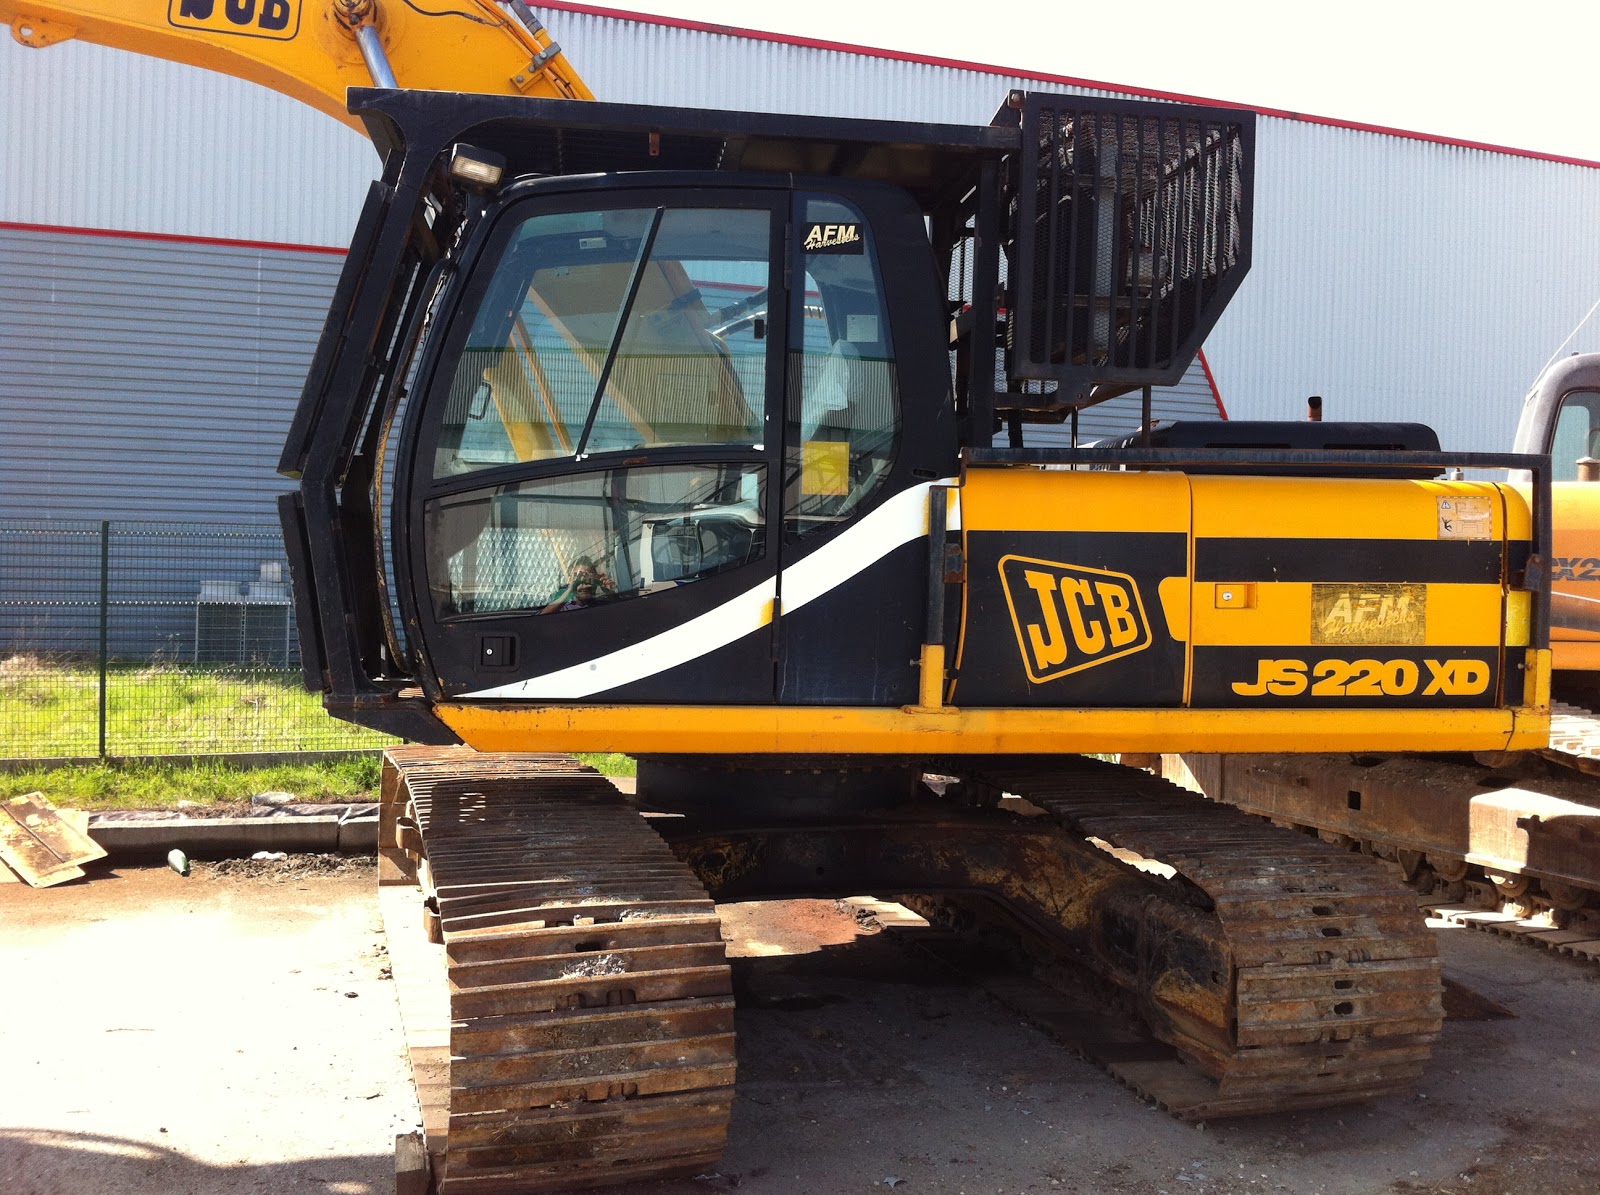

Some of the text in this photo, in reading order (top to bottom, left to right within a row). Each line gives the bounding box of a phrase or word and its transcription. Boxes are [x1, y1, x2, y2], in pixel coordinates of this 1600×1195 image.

[804, 225, 856, 245] AFM
[1024, 569, 1138, 670] JCB
[1321, 593, 1412, 629] AFM
